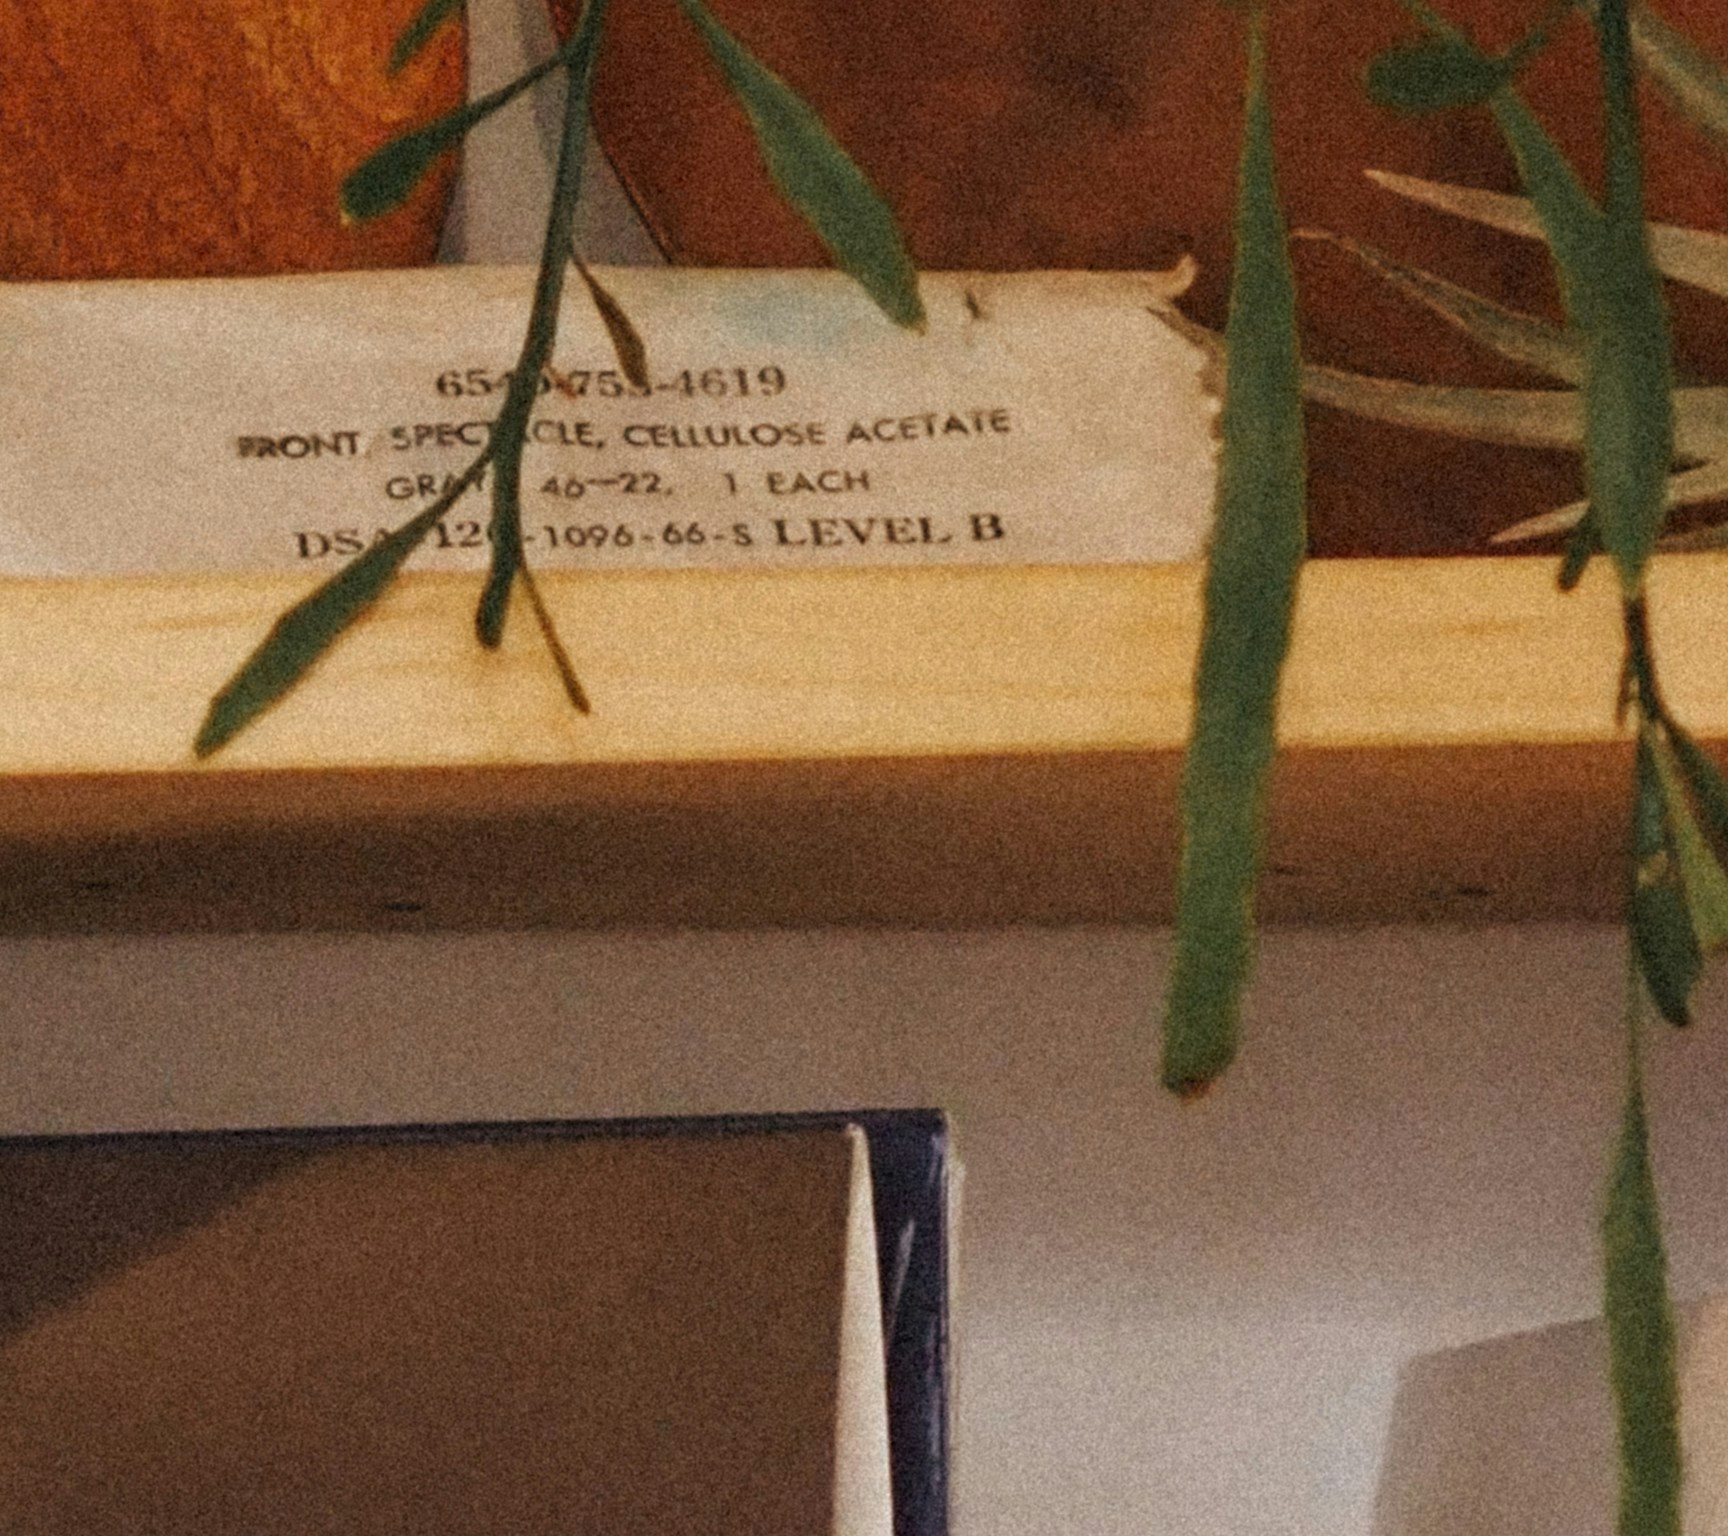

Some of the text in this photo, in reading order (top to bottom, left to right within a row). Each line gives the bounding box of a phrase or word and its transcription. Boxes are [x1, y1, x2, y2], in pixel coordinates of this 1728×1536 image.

[390, 419, 605, 451] SPECCLE,
[624, 422, 826, 449] CELLULOSE
[845, 408, 1012, 443] ACETATE
[767, 469, 870, 495] EACH
[774, 515, 953, 547] LEVEL
[971, 512, 1005, 542] B
